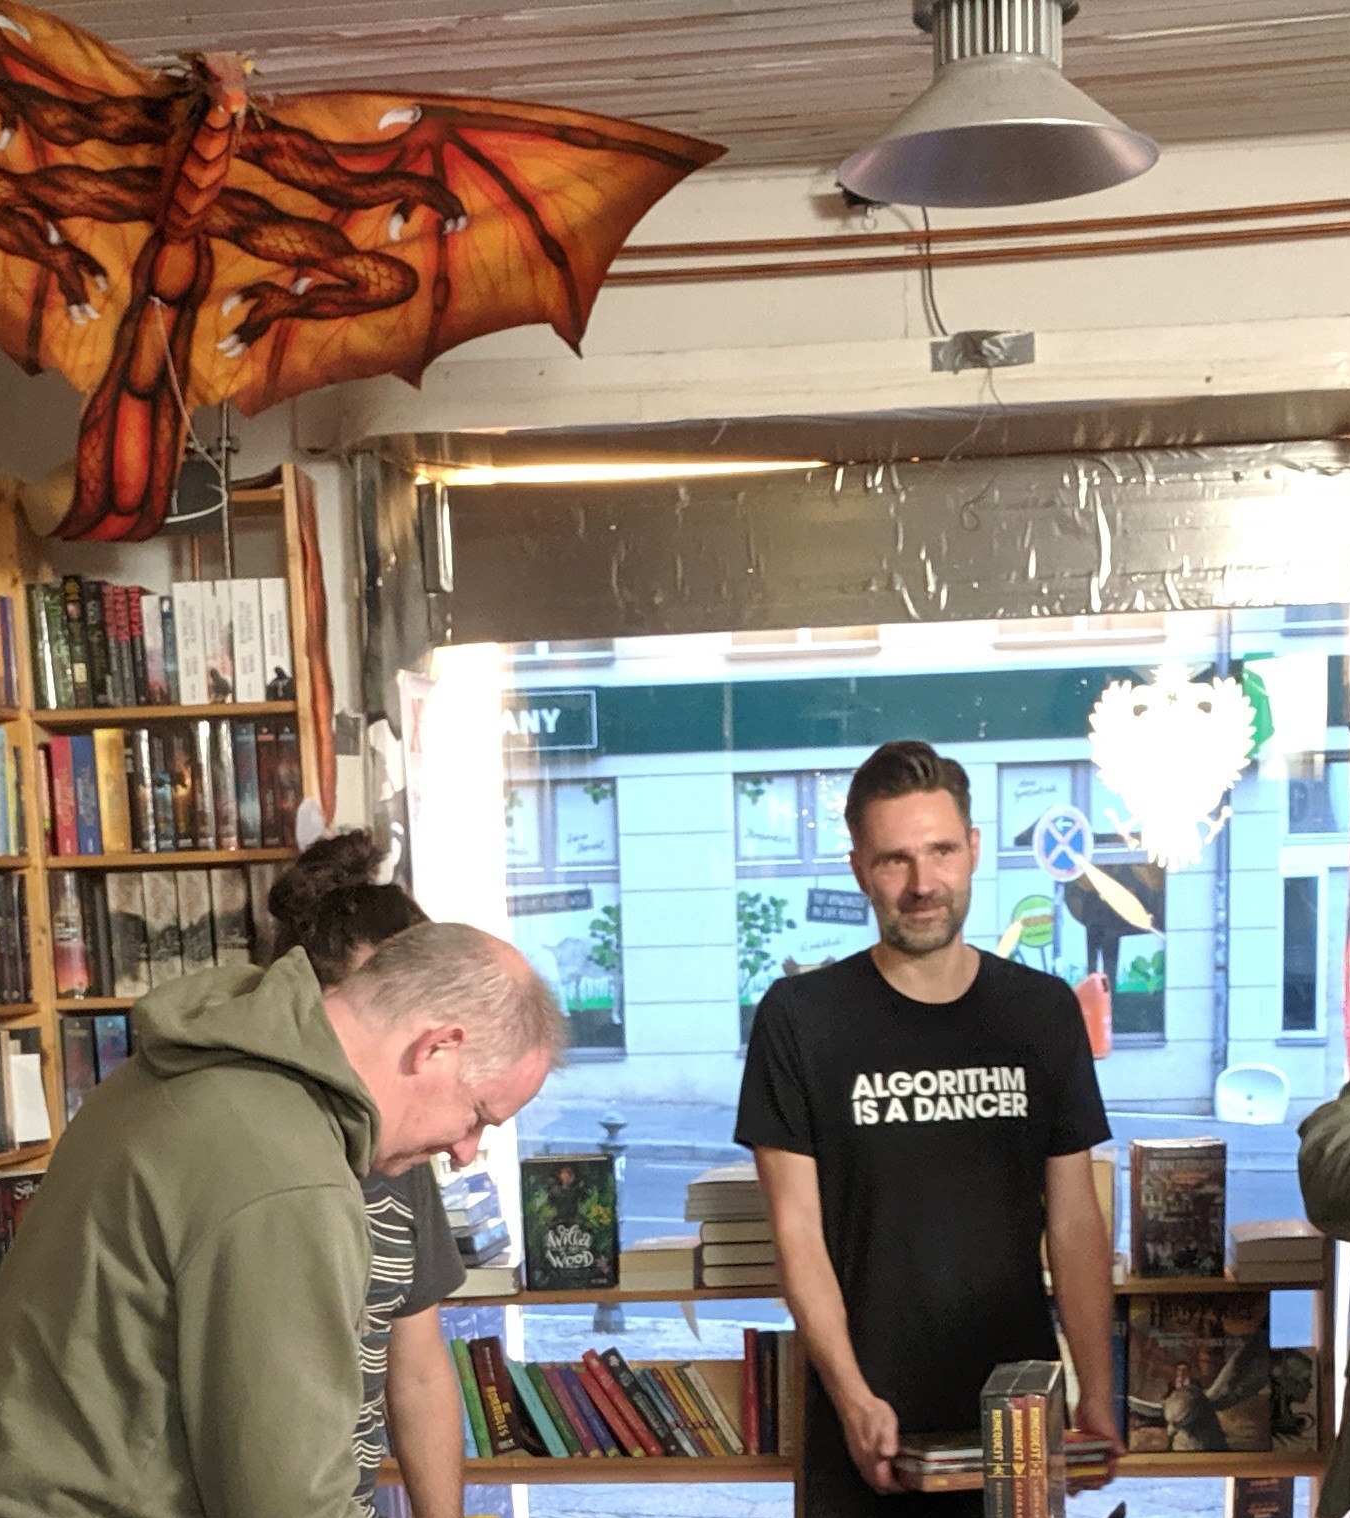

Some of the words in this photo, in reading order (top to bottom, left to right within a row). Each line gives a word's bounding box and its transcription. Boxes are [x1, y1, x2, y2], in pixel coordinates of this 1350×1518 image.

[851, 1066, 1027, 1100] ALGORITHM
[853, 1100, 879, 1126] IS
[885, 1098, 909, 1123] A
[914, 1093, 1028, 1122] DANCER
